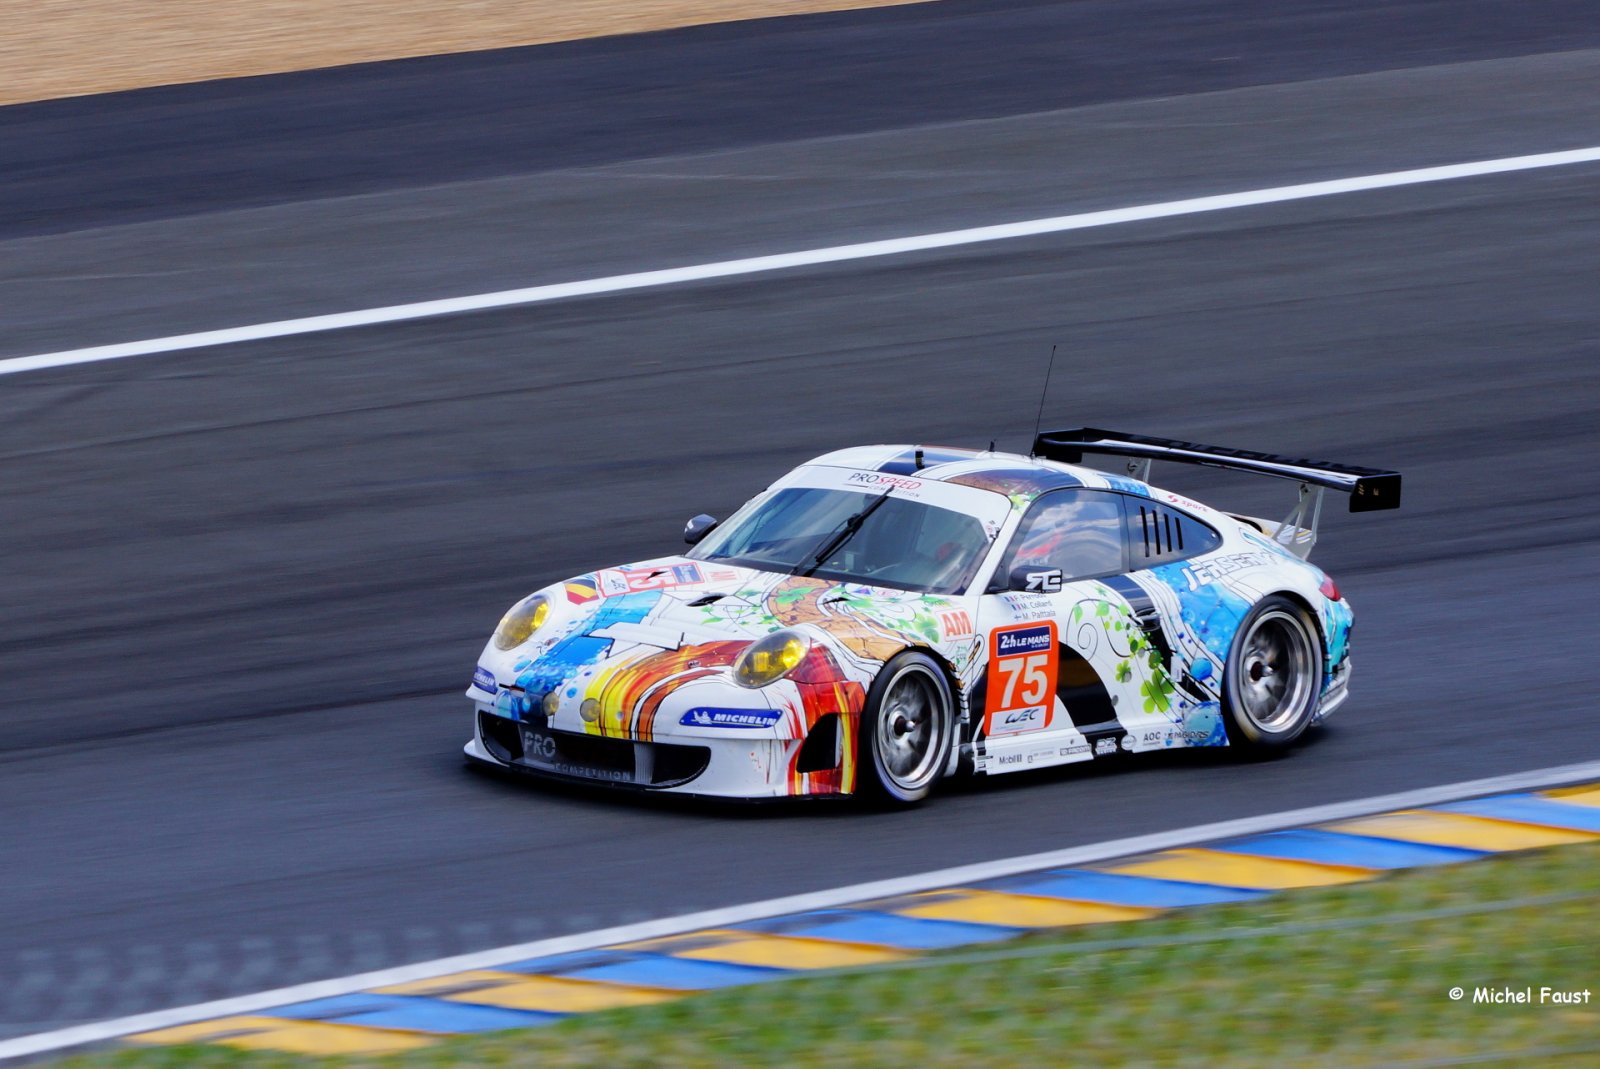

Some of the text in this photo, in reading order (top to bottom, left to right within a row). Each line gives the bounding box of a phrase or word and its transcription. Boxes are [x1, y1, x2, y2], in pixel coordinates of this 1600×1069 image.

[848, 472, 922, 490] PROSPEED
[1182, 500, 1208, 512] spark
[941, 610, 972, 637] AM
[1017, 637, 1027, 647] LE
[1027, 634, 1050, 645] MANS
[998, 653, 1048, 709] 75
[713, 713, 777, 726] MICHELIN
[1005, 708, 1039, 724] WEC
[523, 731, 556, 758] PRO
